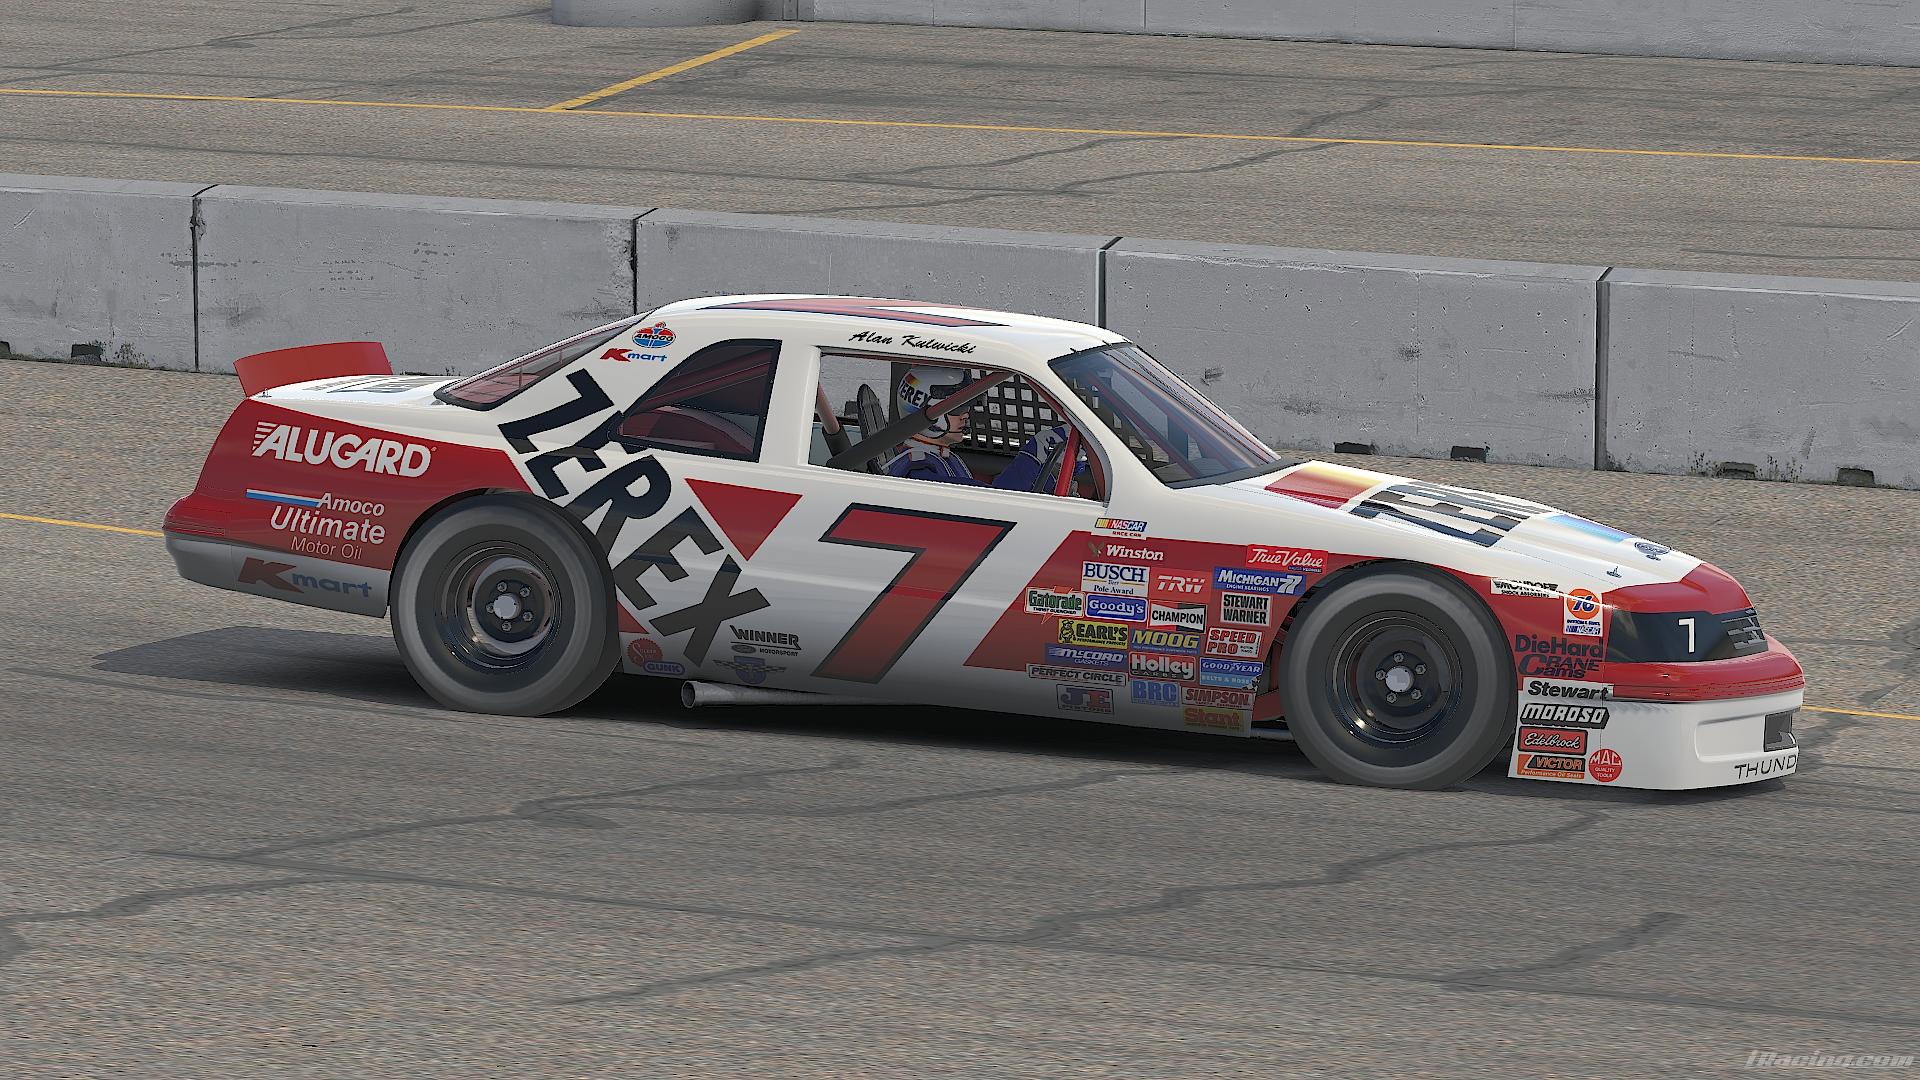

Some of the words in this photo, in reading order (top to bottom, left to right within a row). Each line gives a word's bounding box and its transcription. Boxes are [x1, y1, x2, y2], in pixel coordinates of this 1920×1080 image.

[634, 332, 674, 342] AMOCO
[849, 331, 892, 345] Alan
[902, 334, 977, 354] Kulwicki
[899, 380, 931, 408] EREX
[252, 422, 432, 478] ALUGARD
[316, 492, 385, 517] Amoco
[270, 506, 386, 544] Ultimate
[497, 368, 771, 668] ZEREX
[1110, 520, 1145, 532] NASCAR
[291, 537, 336, 556] Motor
[341, 544, 362, 559] Oil
[1106, 544, 1164, 560] Winston
[1083, 563, 1147, 582] BUSCH
[1218, 570, 1280, 587] MICHIGAN
[809, 502, 1018, 684] 7
[1094, 584, 1110, 593] Pole
[1112, 587, 1134, 595] Award
[1157, 575, 1205, 593] TRW
[1028, 590, 1082, 611] Gatorade
[1089, 600, 1144, 614] Goody's
[1223, 594, 1269, 610] STEWART
[1571, 595, 1595, 612] 76
[1152, 610, 1203, 625] CHAMPION
[1223, 608, 1267, 624] WARNER
[729, 625, 801, 650] WINNER
[1076, 623, 1127, 641] EARL'S
[1131, 629, 1200, 648] MOOG
[1210, 629, 1256, 644] SPEED
[1207, 642, 1239, 654] PRO
[1515, 634, 1603, 658] DieHard
[1032, 667, 1081, 680] PERFECT
[1083, 671, 1123, 683] CIRCLE
[1131, 653, 1194, 679] Holley
[1186, 688, 1249, 706] SIMPSON
[1528, 680, 1608, 699] Stewart
[1521, 704, 1606, 724] MOROSO
[1524, 733, 1580, 748] Edelbrock
[1536, 756, 1582, 770] VICTOR
[1590, 750, 1621, 765] MAC
